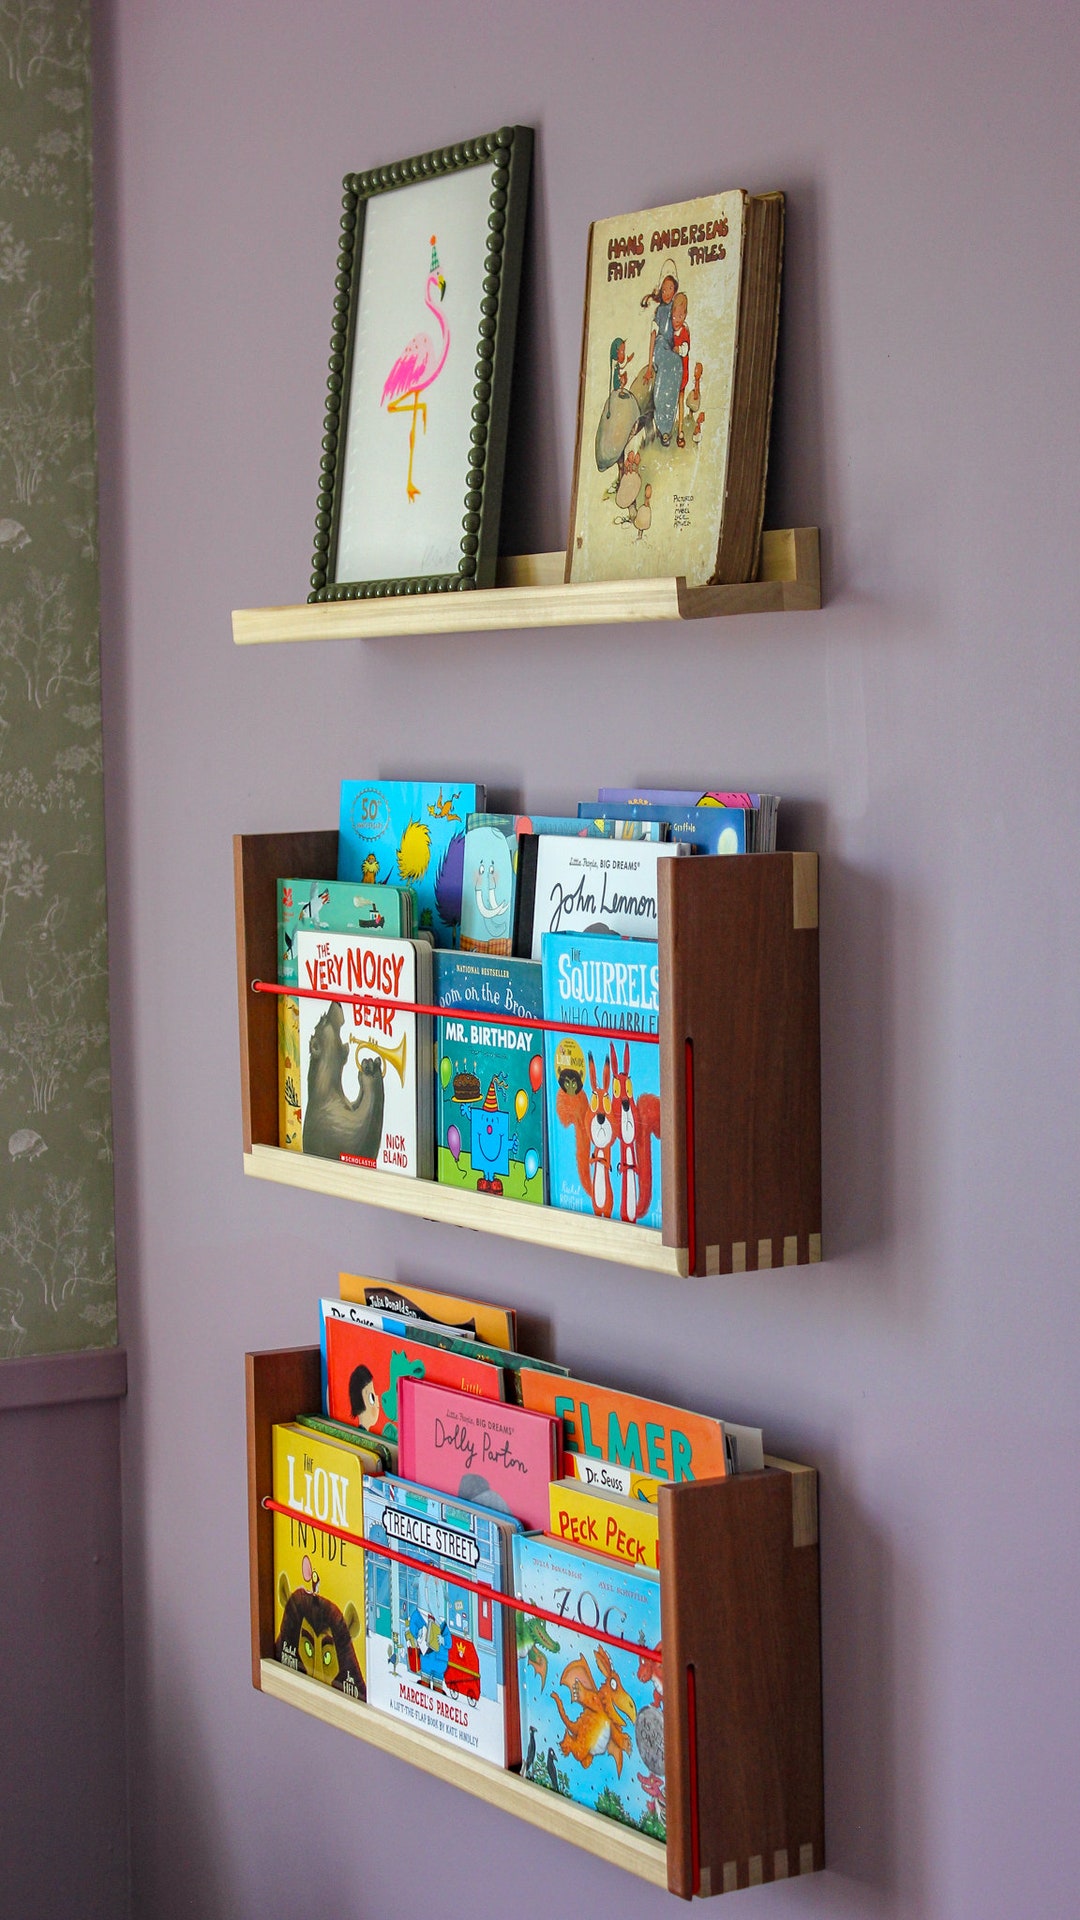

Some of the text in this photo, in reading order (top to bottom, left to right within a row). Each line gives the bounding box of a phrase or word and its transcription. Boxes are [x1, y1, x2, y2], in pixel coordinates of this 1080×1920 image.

[607, 233, 645, 260] HANS
[607, 243, 727, 282] FAIRY TALES
[600, 859, 611, 869] BIG
[549, 871, 657, 934] John Lennon
[317, 942, 331, 959] THE
[305, 947, 405, 998] VERY NOISY
[456, 964, 510, 979] NATIONAL BESTSELLER
[352, 993, 396, 1037] BEAR
[439, 982, 538, 1020] oom on the Broo
[594, 1006, 659, 1034] SQUABBLE
[445, 1022, 533, 1052] MR. BIRTHDAY
[385, 1133, 406, 1151] NICK
[344, 1155, 377, 1168] SCHOLASTIC
[383, 1149, 408, 1169] BLAND
[369, 1295, 418, 1319] Julia Donaldson
[476, 1417, 487, 1428] BIG
[435, 1418, 528, 1474] Dolly Parton
[555, 1396, 696, 1483] ELMER
[585, 1467, 623, 1491] Dr. Seuss
[387, 1511, 474, 1562] TREACLE STREET
[559, 1511, 598, 1543] PECK
[606, 1516, 646, 1564] PECK
[389, 1699, 394, 1708] A
[399, 1682, 469, 1727] MARCEL'S PARCELS
